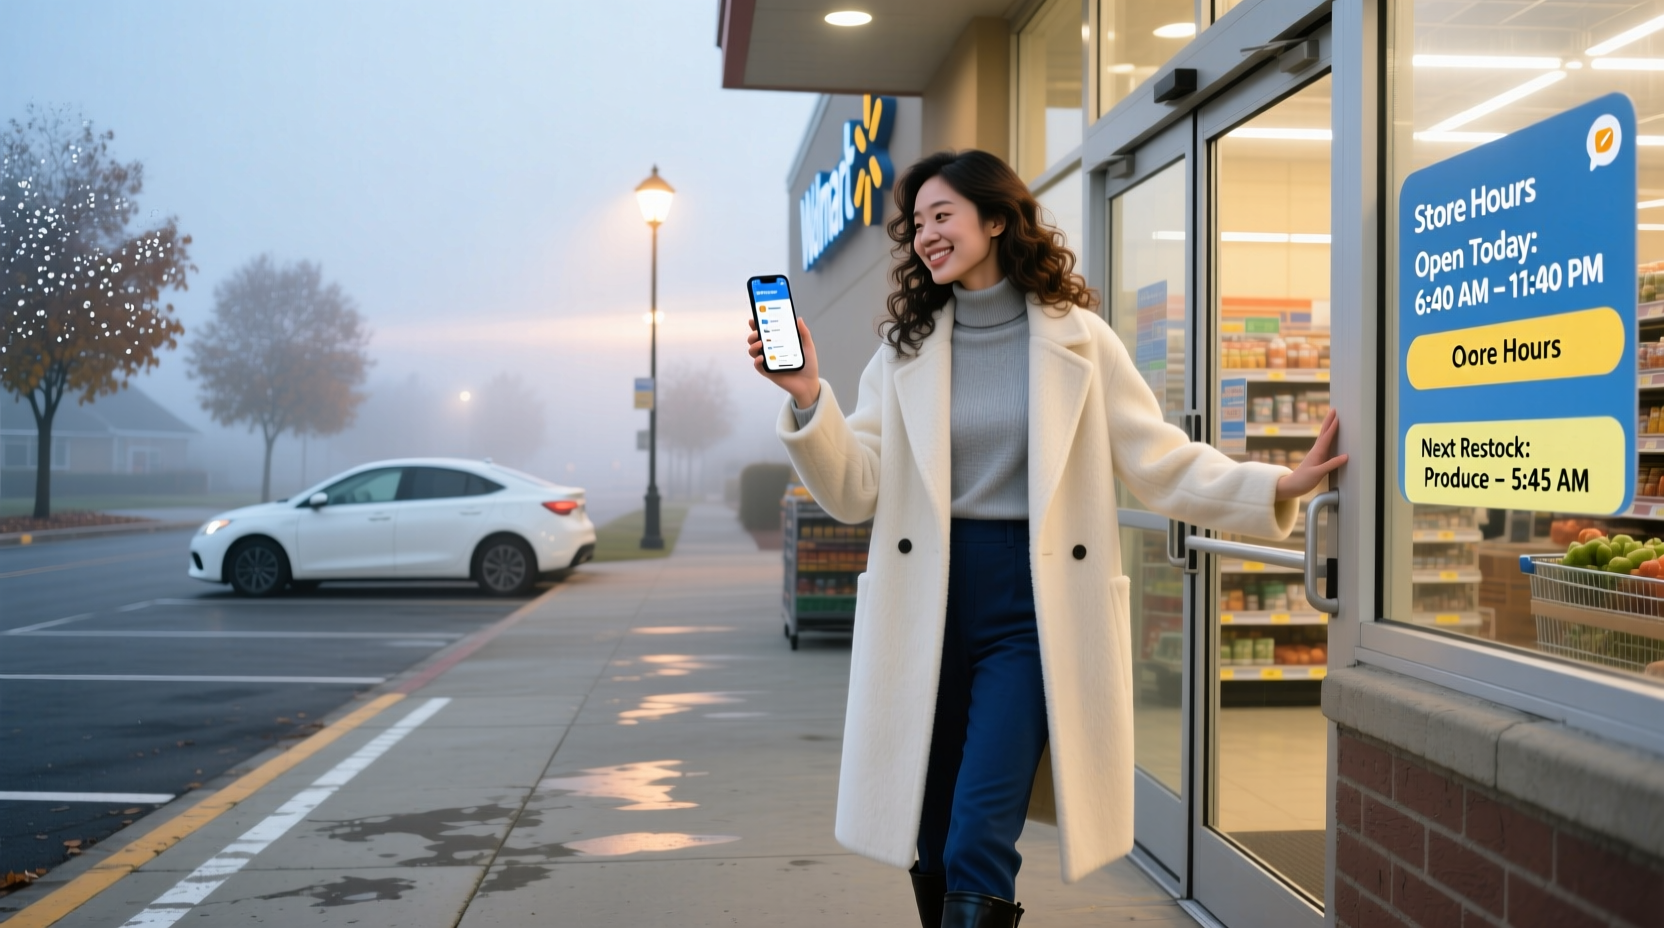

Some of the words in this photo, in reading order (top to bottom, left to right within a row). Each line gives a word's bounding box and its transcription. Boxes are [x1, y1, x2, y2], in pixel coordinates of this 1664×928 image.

[1414, 199, 1466, 234] Store
[1471, 177, 1536, 218] Hours
[1415, 248, 1464, 282] Open
[1469, 229, 1538, 266] Today:
[1415, 284, 1454, 316] 6:40
[1458, 277, 1489, 308] AM
[1509, 262, 1562, 298] 11:40
[1568, 252, 1604, 288] PM
[1503, 338, 1561, 363] Hours
[1421, 437, 1456, 459] Next
[1460, 436, 1531, 459] Restock:
[1424, 467, 1489, 490] Produce
[1511, 467, 1552, 491] 5:45
[1556, 468, 1589, 493] AM
